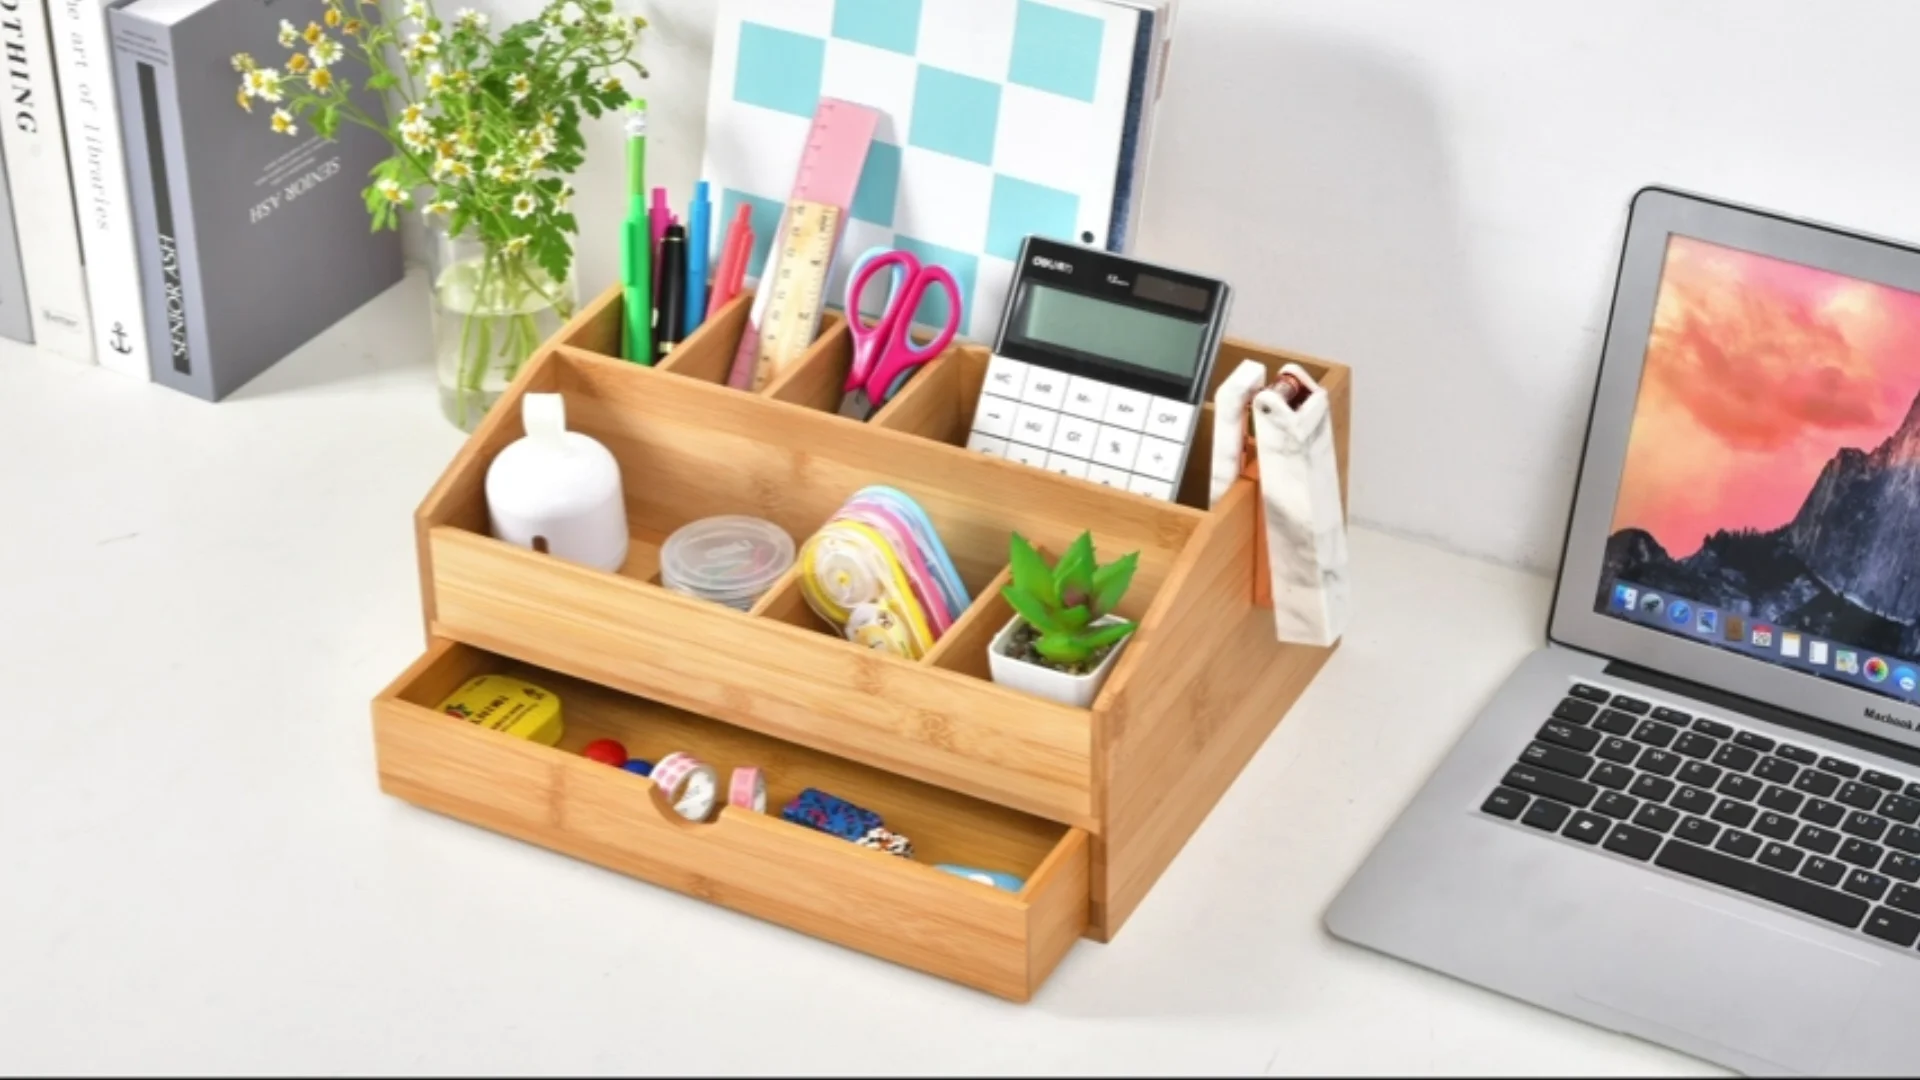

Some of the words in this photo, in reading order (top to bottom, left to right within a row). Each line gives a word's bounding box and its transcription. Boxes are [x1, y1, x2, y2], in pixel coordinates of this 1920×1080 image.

[283, 155, 341, 203] SENIOR
[248, 190, 282, 224] ASH
[159, 233, 181, 280] ASH
[166, 281, 188, 360] SENIOR
